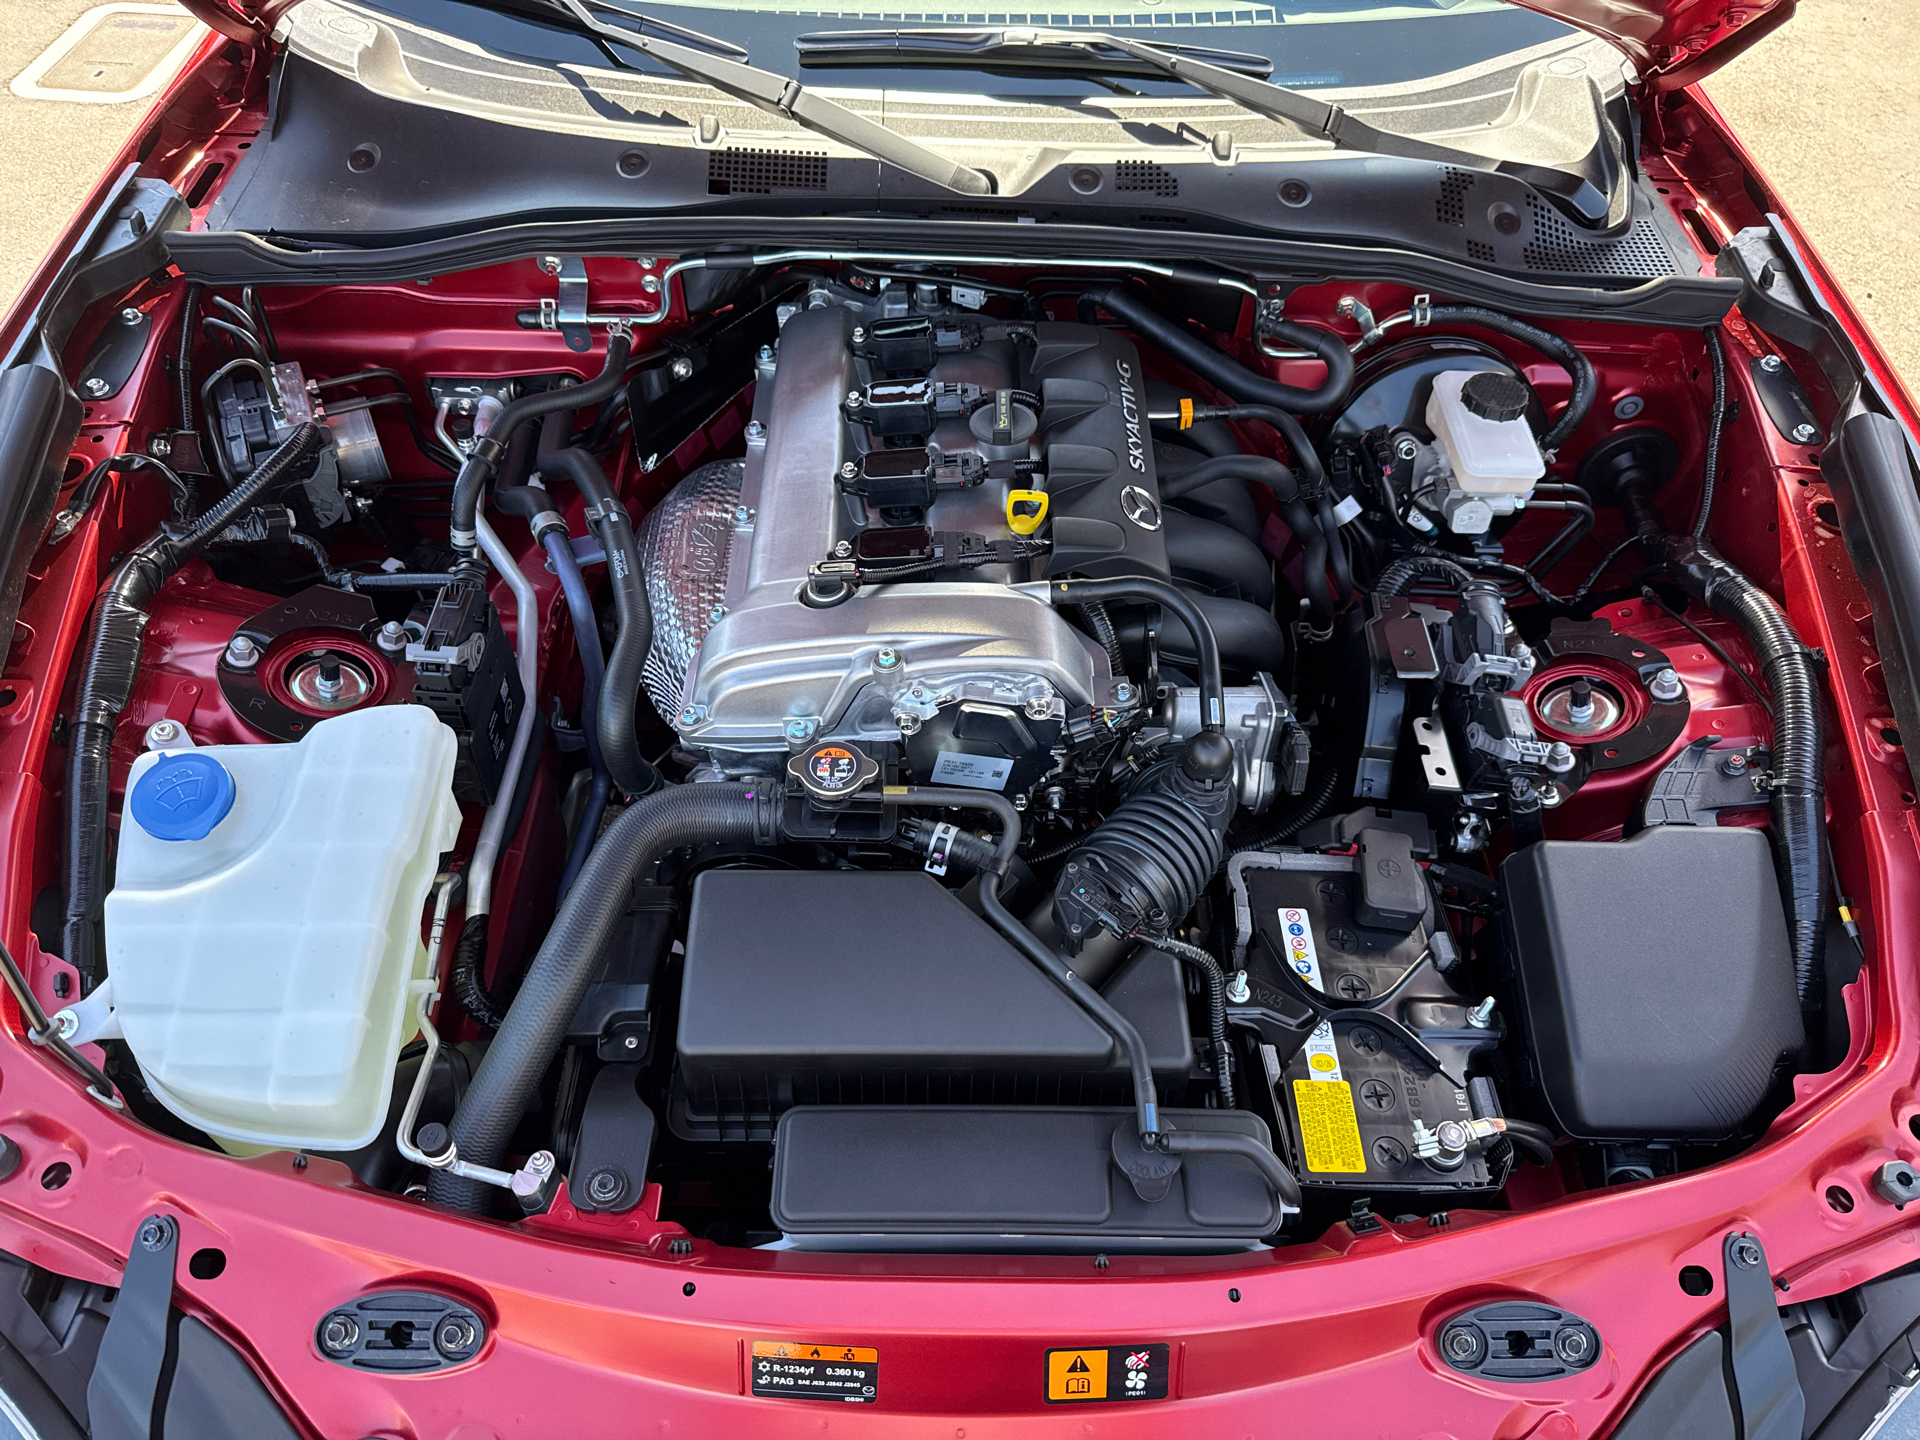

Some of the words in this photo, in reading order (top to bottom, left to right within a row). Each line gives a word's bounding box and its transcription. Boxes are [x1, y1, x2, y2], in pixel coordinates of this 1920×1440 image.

[1116, 359, 1146, 473] SKYACTIV-G
[305, 608, 352, 624] N243
[248, 698, 266, 710] R
[1253, 987, 1283, 1008] N243
[1316, 1060, 1332, 1068] 02/26
[1315, 1093, 1326, 1115] POISON
[1343, 1095, 1355, 1123] DANGER
[1320, 1116, 1328, 1132] CAUSES
[1127, 1160, 1171, 1179] COOLANT
[773, 1364, 814, 1375] R-1234yf
[826, 1368, 851, 1376] 0.360
[853, 1368, 865, 1378] kg
[773, 1377, 794, 1385] PAG
